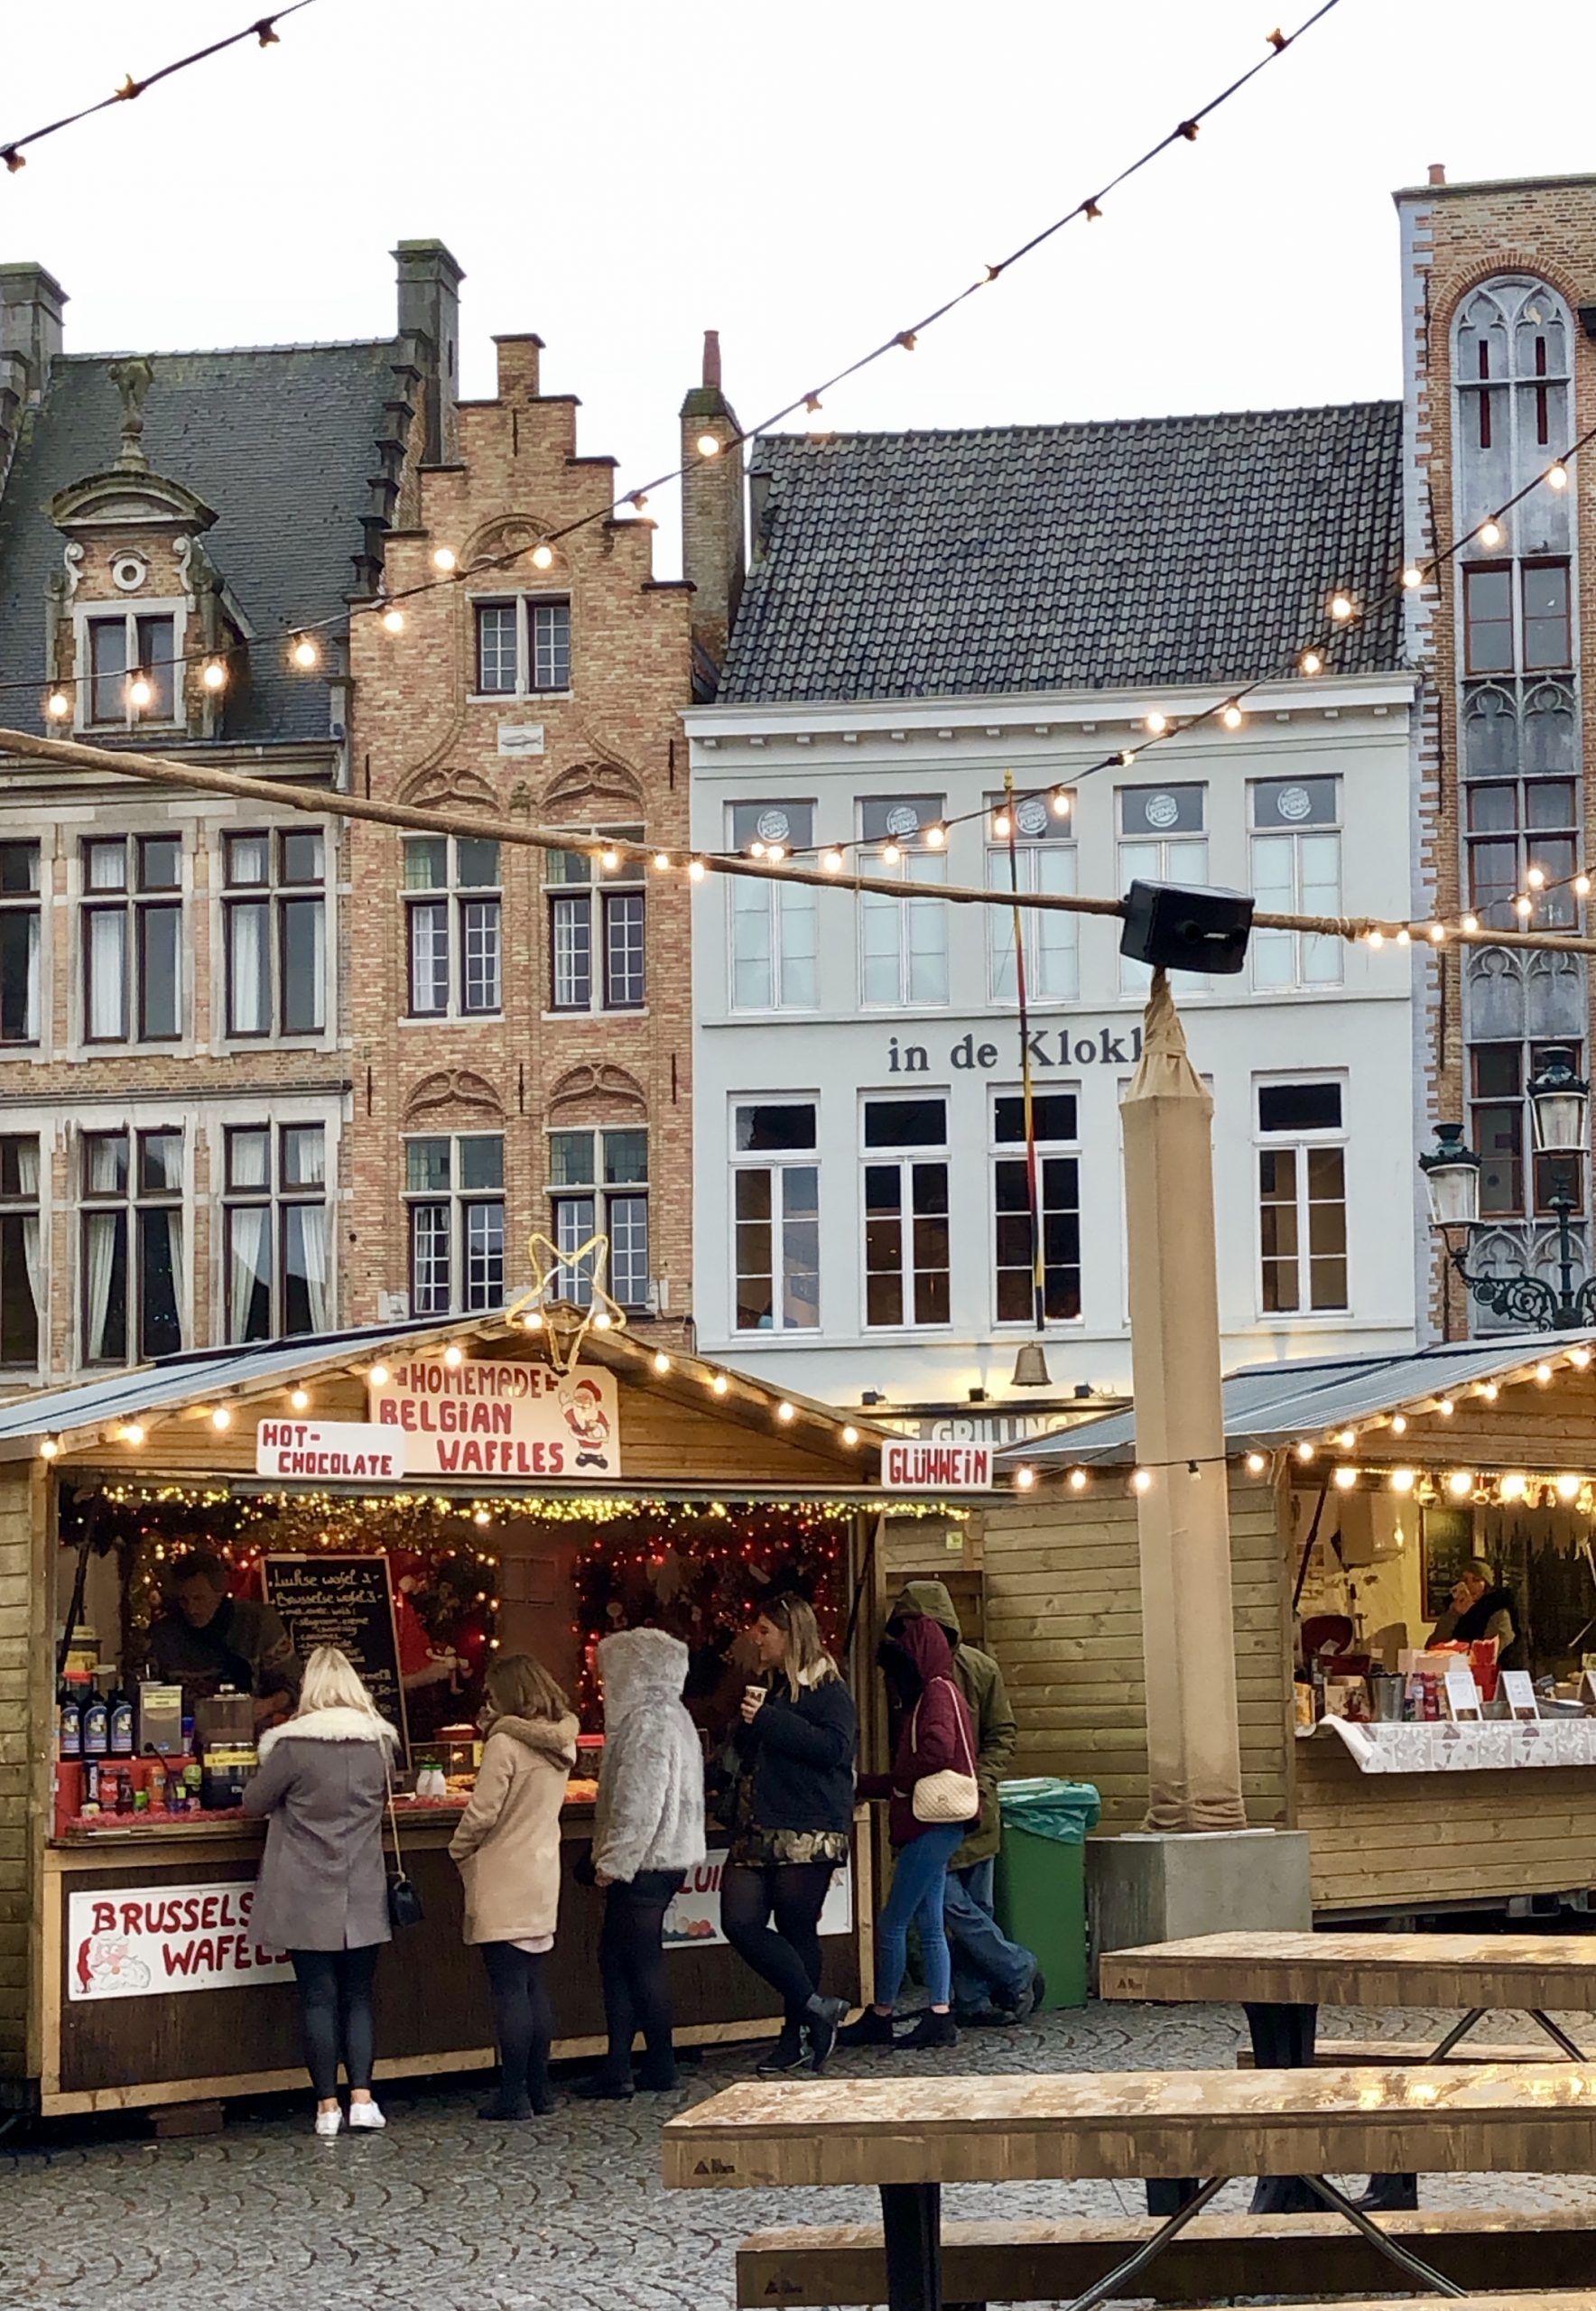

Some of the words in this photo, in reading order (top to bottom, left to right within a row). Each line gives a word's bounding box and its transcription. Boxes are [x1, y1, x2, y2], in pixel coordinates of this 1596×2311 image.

[888, 1036, 930, 1072] in
[951, 1034, 998, 1069] de
[411, 1363, 540, 1398] HOMEMADE
[278, 1451, 393, 1476] CHOCOLATE
[437, 1440, 564, 1473] WAFFLES
